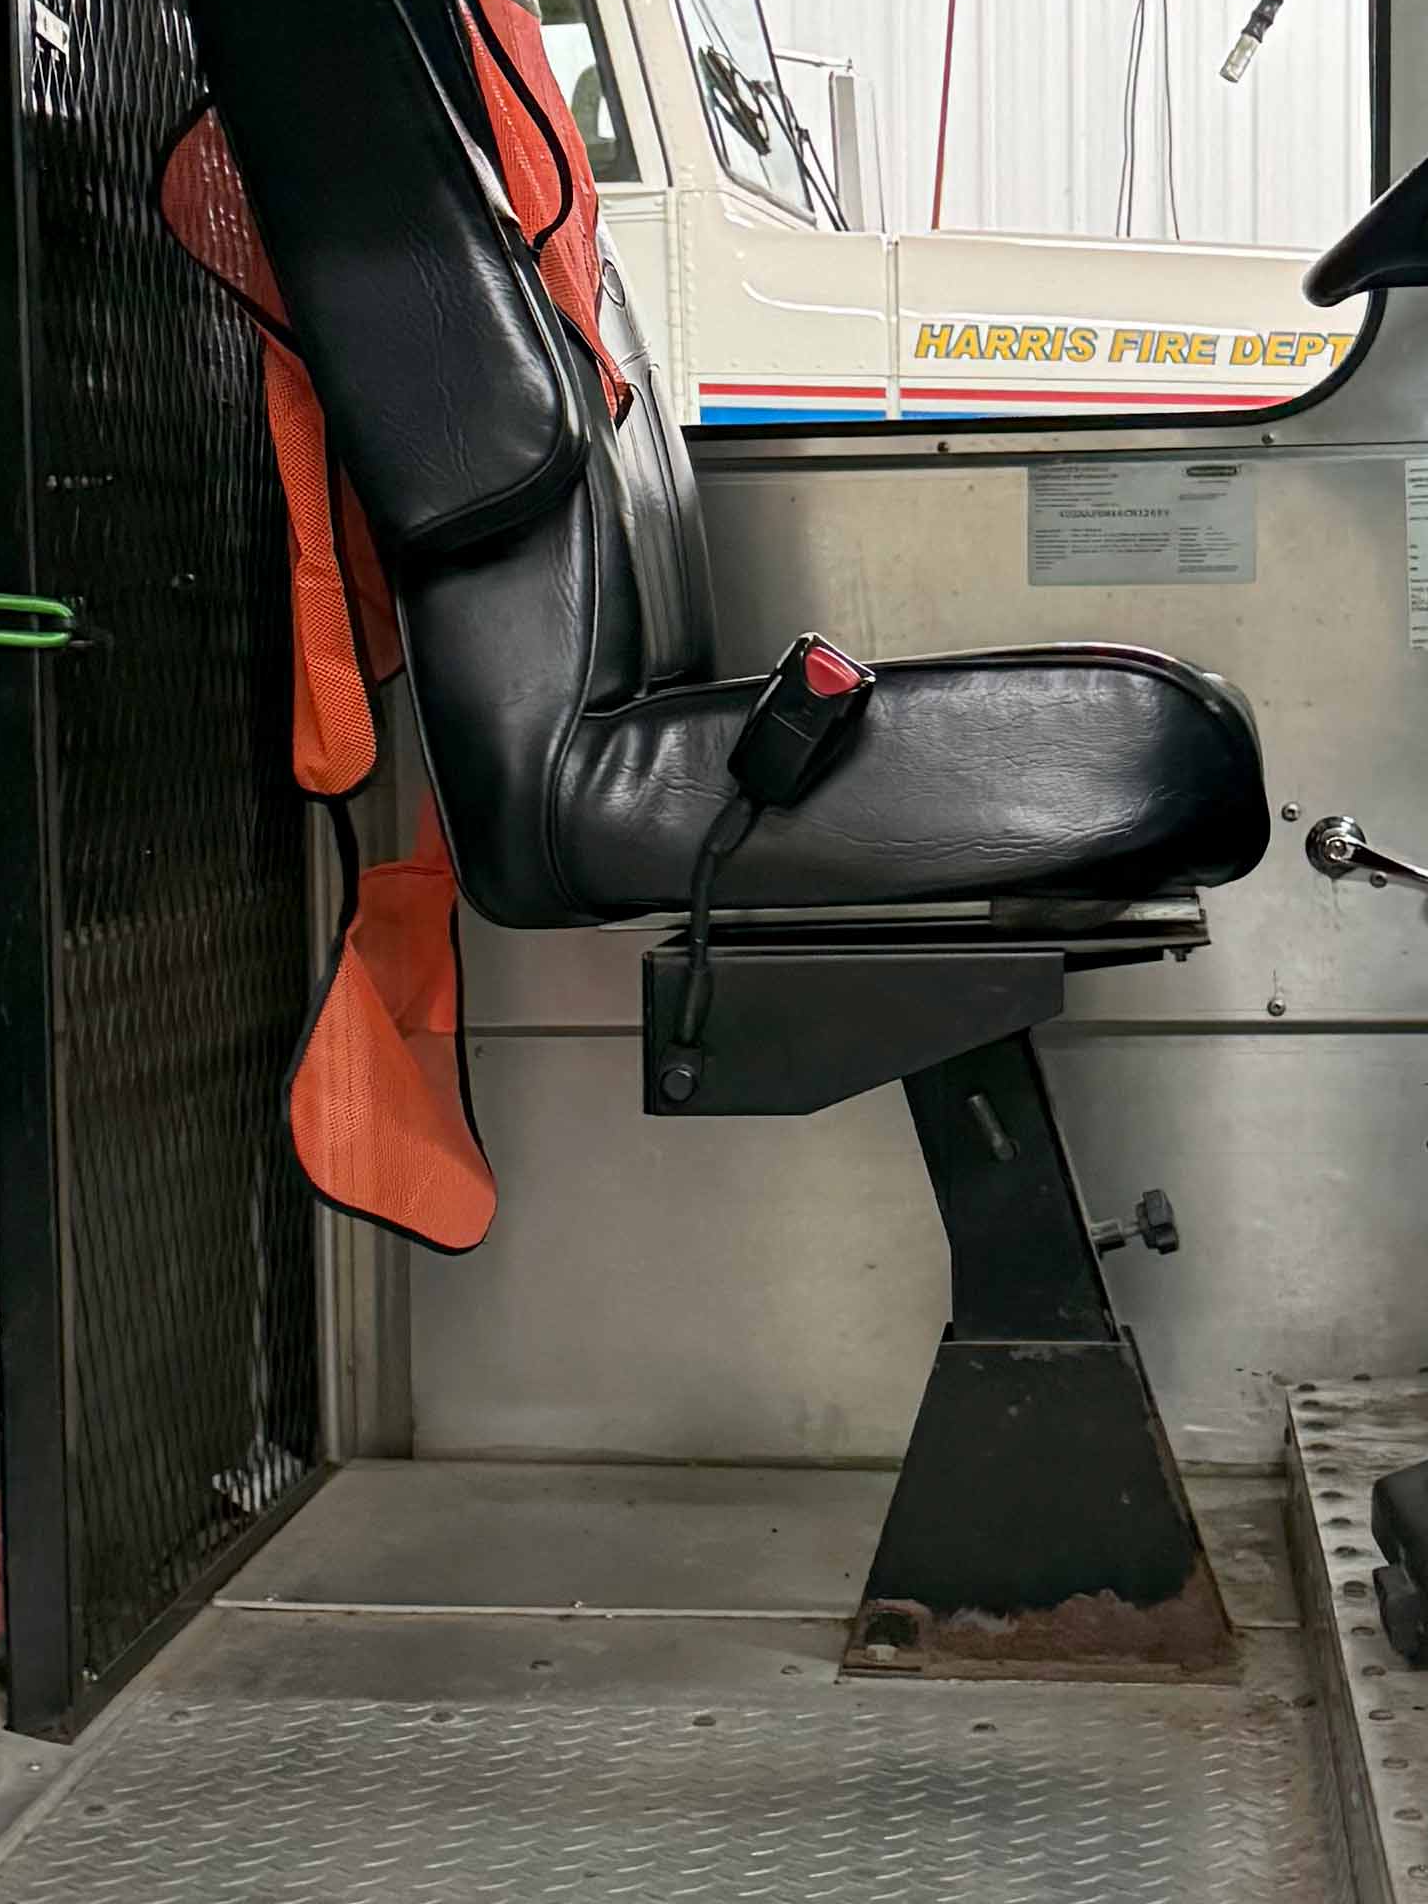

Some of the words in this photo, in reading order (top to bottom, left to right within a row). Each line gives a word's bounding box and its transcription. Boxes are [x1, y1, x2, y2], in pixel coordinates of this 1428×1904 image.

[915, 324, 1098, 362] HARRIS
[1108, 328, 1220, 365] FIRE
[1229, 331, 1359, 367] DEPT
